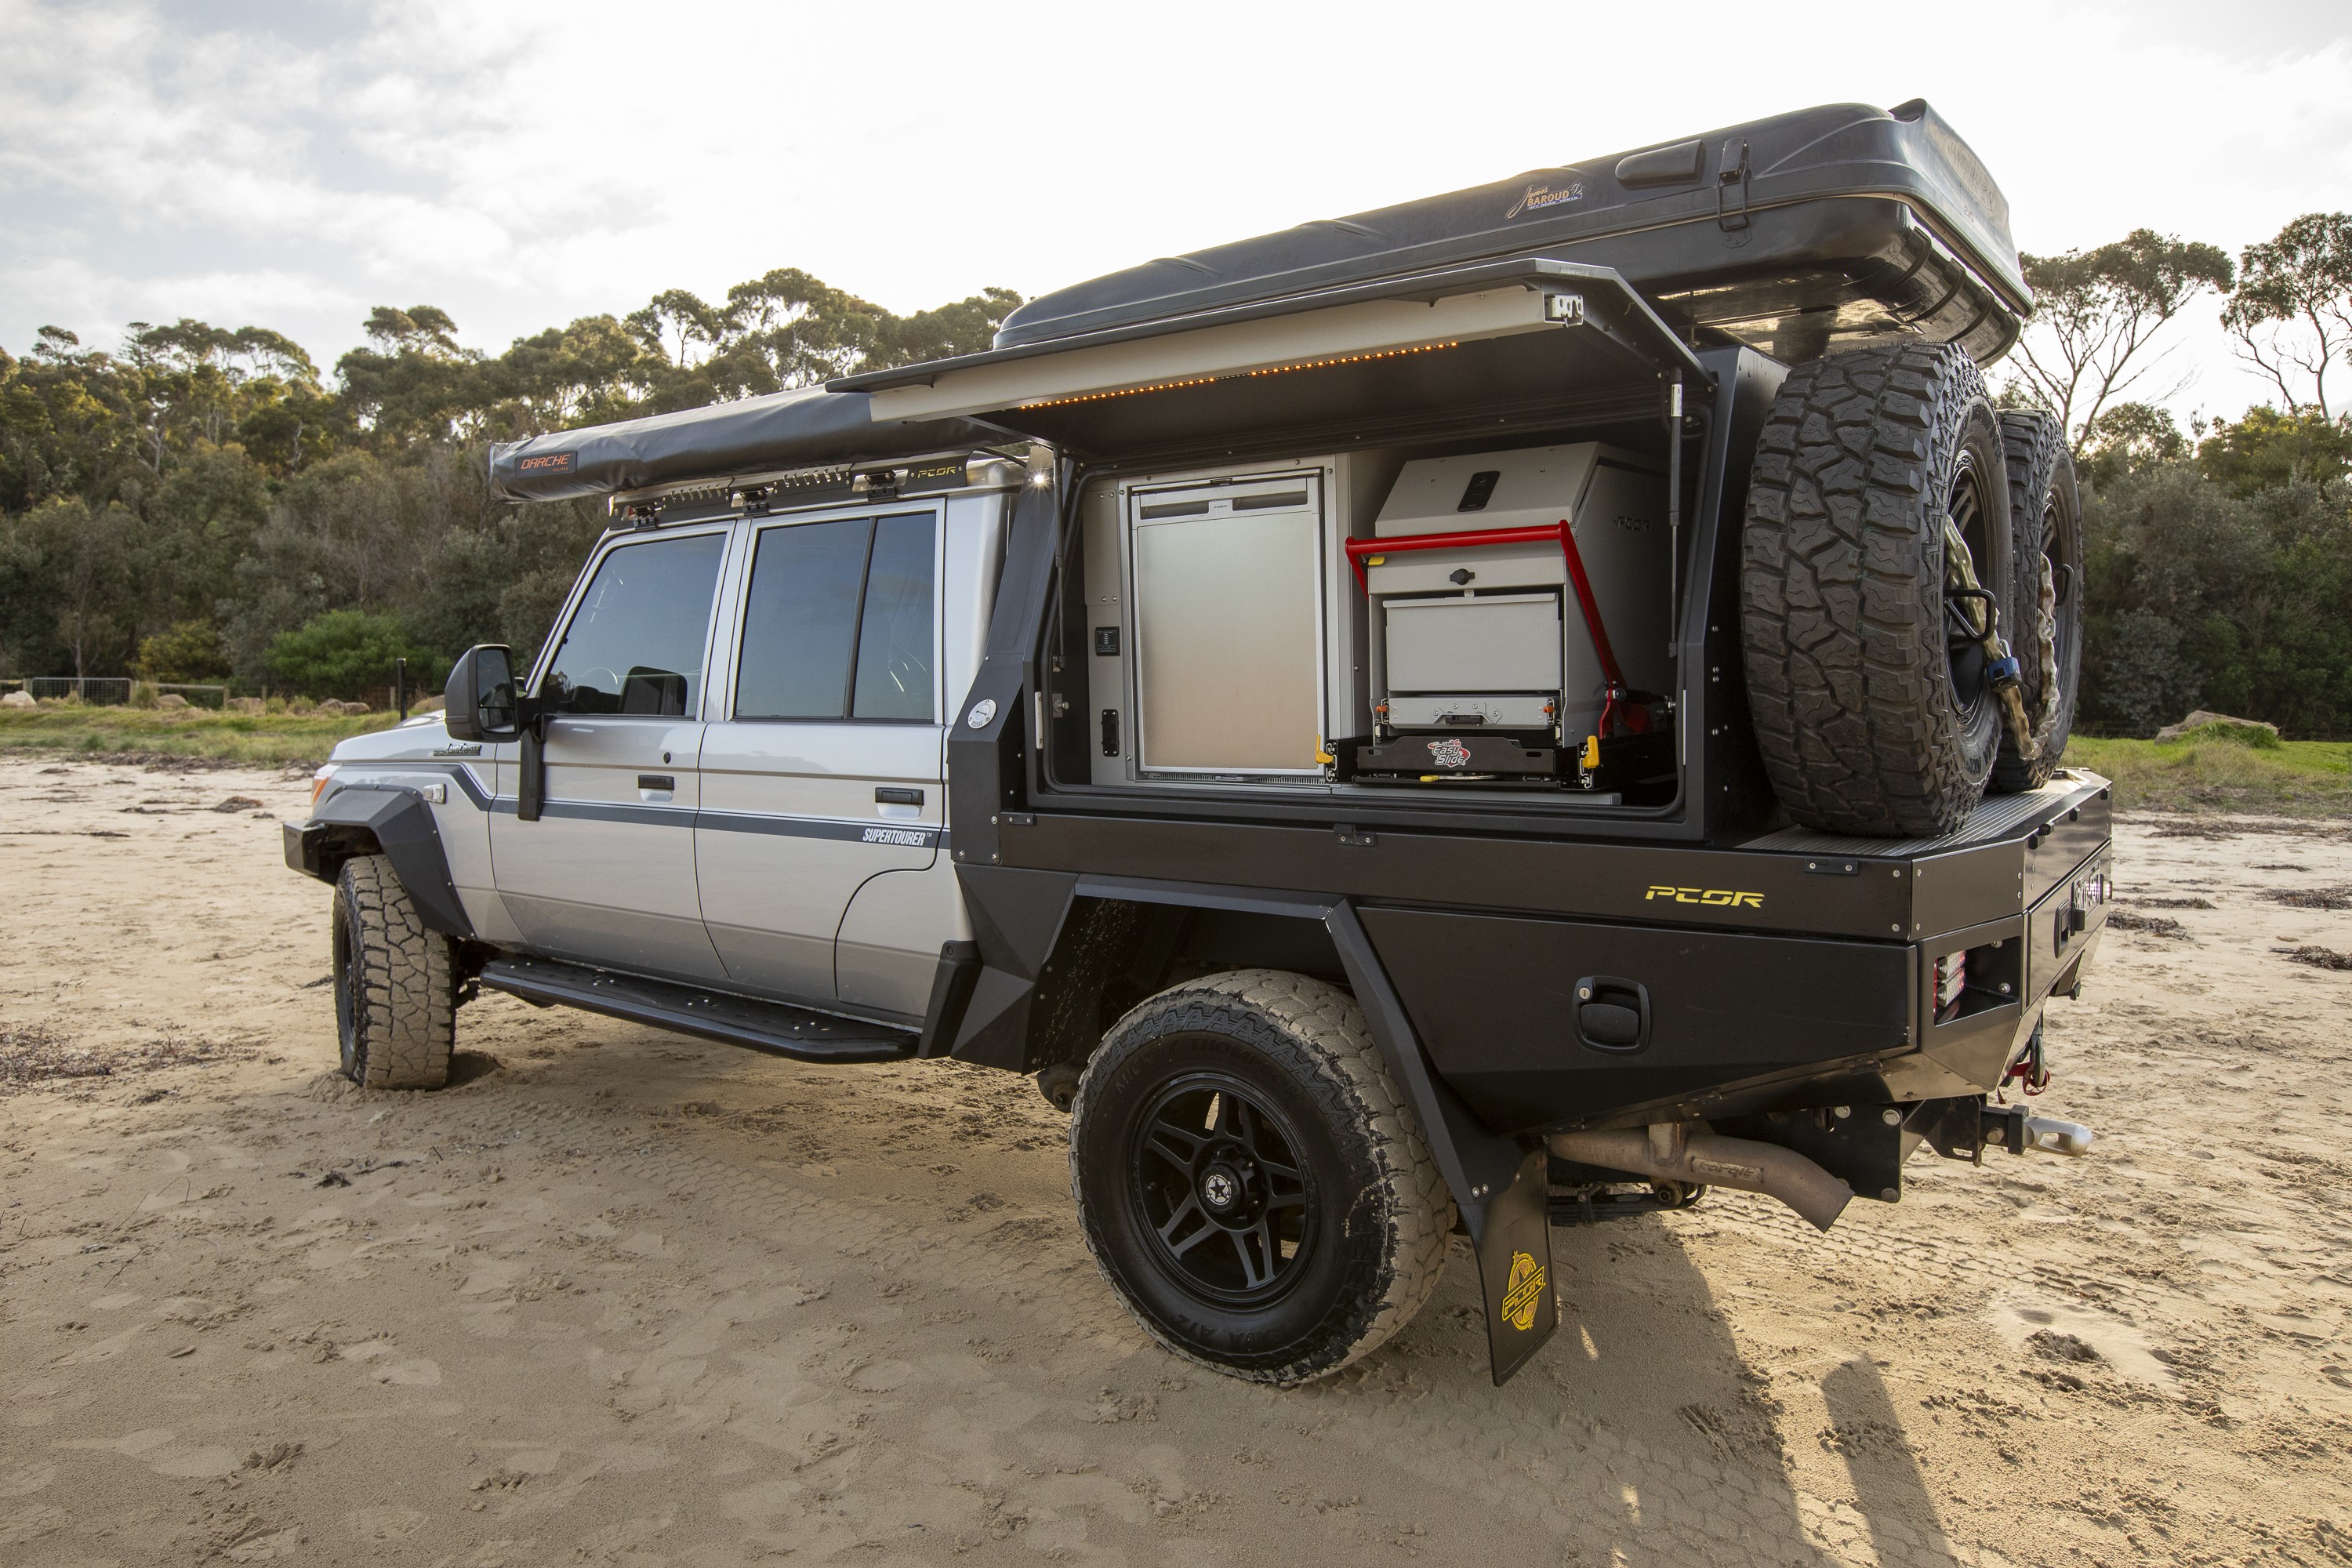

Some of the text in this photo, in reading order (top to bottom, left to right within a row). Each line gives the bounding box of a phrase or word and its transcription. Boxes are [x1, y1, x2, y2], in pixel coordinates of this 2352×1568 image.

[1527, 190, 1570, 207] BAROUD
[521, 454, 572, 470] DARCHE
[917, 466, 956, 478] PCOR
[1433, 746, 1461, 756] Easy
[1437, 754, 1465, 764] Slide
[1645, 885, 1766, 909] PCOR
[1188, 1037, 1305, 1102] THOMPSON
